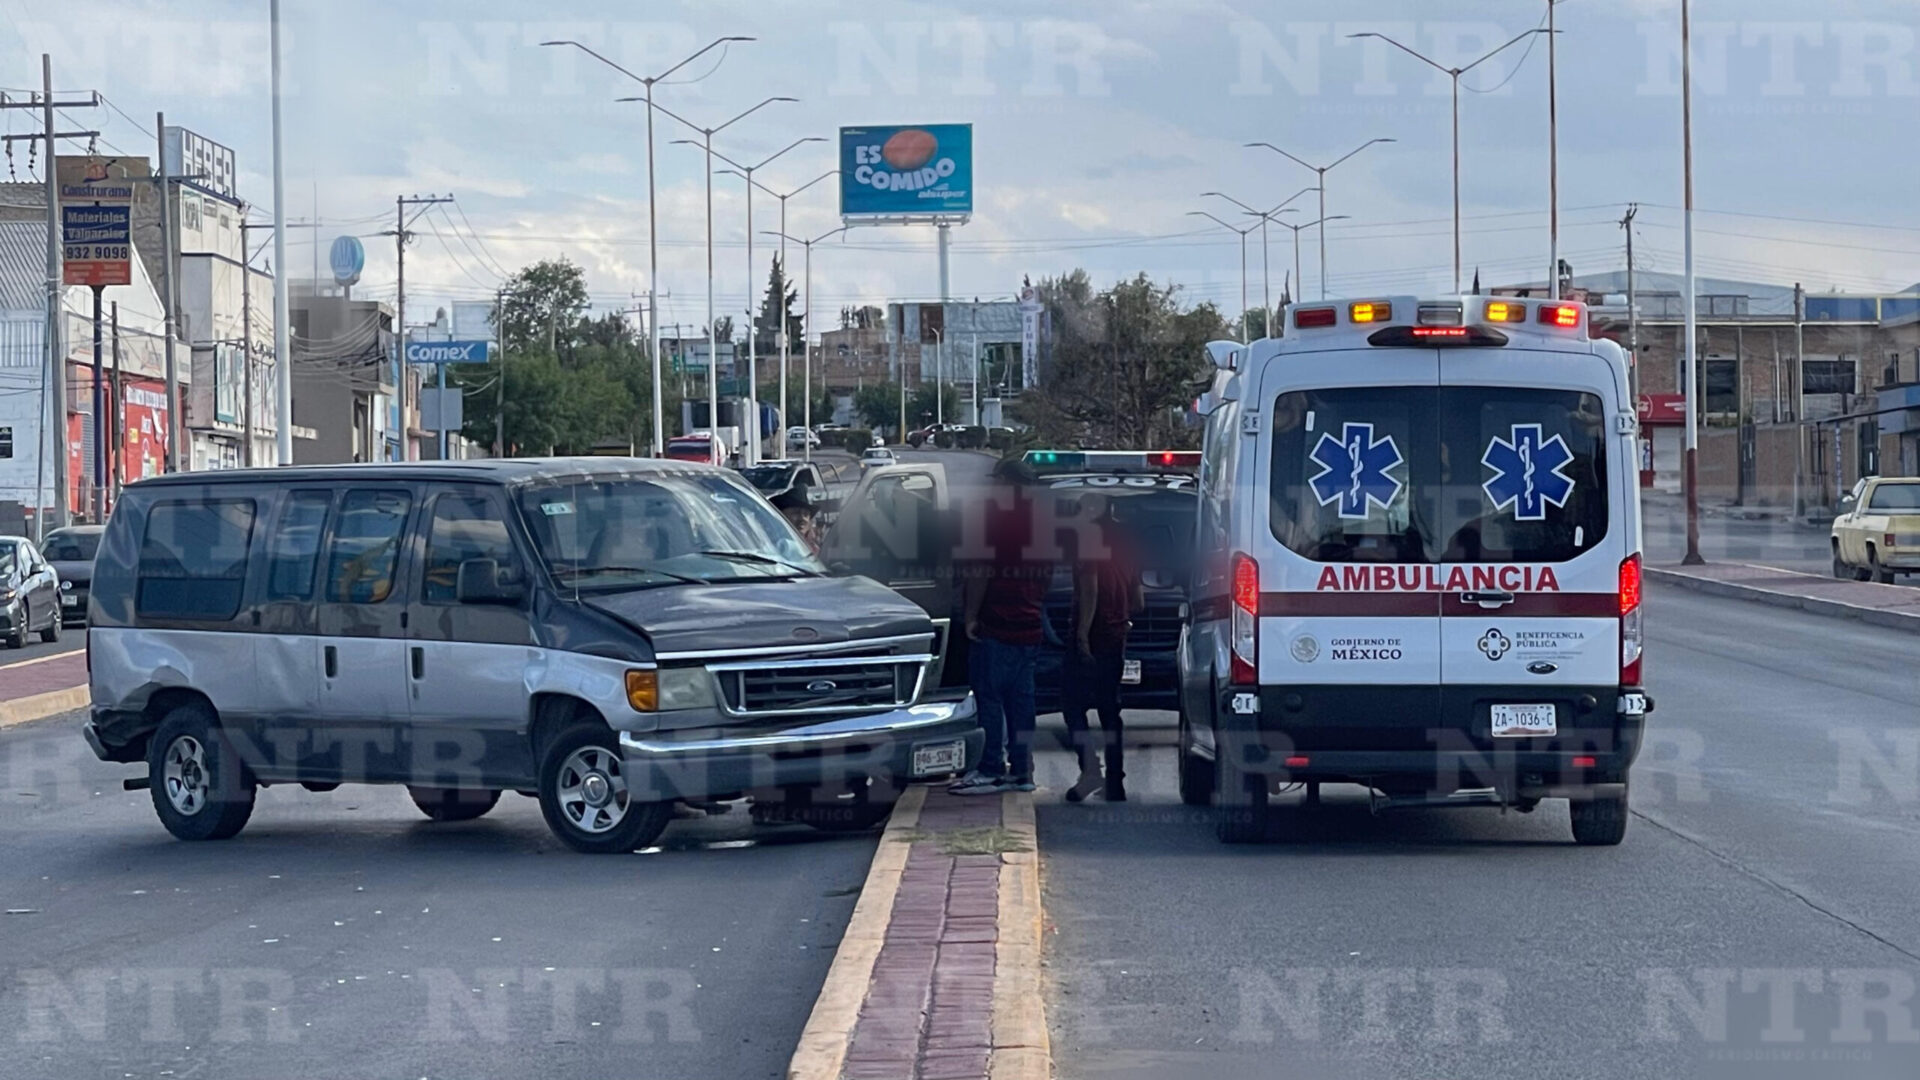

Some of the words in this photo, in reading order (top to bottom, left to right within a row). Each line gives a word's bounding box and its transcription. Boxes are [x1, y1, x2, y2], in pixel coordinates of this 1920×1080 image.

[856, 145, 882, 164] ES
[855, 157, 956, 191] COMIDO
[67, 211, 126, 223] Materiales
[66, 246, 90, 259] 932
[95, 246, 128, 259] 9098
[407, 343, 476, 361] Comex
[1317, 565, 1560, 592] AMBULANCIA
[1331, 638, 1385, 647] GOBIERNO
[1388, 638, 1401, 646] DE
[1516, 632, 1584, 640] BENEFICENCIA
[1516, 639, 1557, 648] PÚBLICA
[1332, 646, 1402, 660] MÉXICO
[1494, 711, 1553, 727] ZA-1036-C
